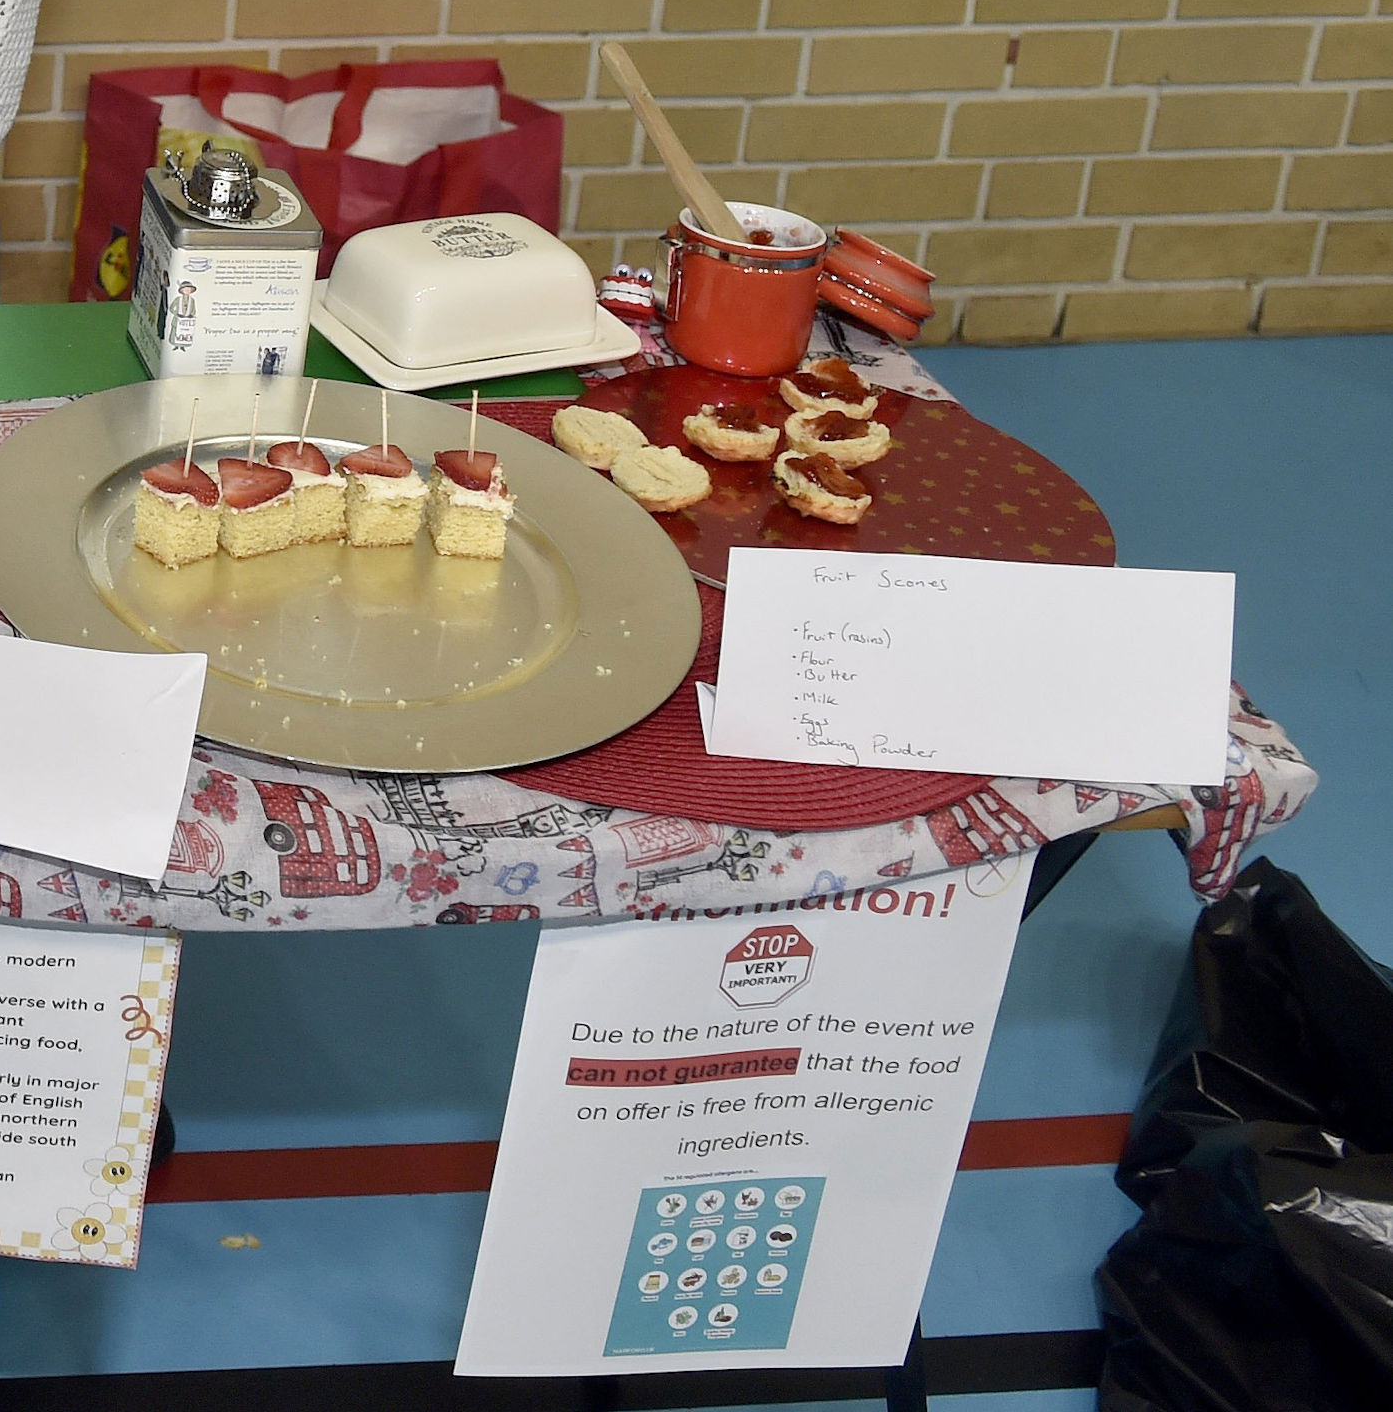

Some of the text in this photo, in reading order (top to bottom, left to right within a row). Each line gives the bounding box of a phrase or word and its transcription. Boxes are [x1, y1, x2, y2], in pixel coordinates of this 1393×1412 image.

[432, 232, 512, 247] BUTTER
[814, 566, 948, 592] Fruit Scones
[800, 650, 835, 666] Flour
[802, 691, 839, 706] Milk
[800, 712, 829, 736] Eggs
[807, 733, 938, 766] Baking Powder
[742, 935, 800, 959] STOP
[6, 954, 76, 968] modern
[744, 960, 788, 976] VERY
[727, 974, 798, 989] IMPORTANT!
[51, 997, 88, 1011] with
[93, 1002, 105, 1012] a
[571, 1013, 975, 1044] Due to the nature of the event we
[37, 1036, 82, 1053] food,
